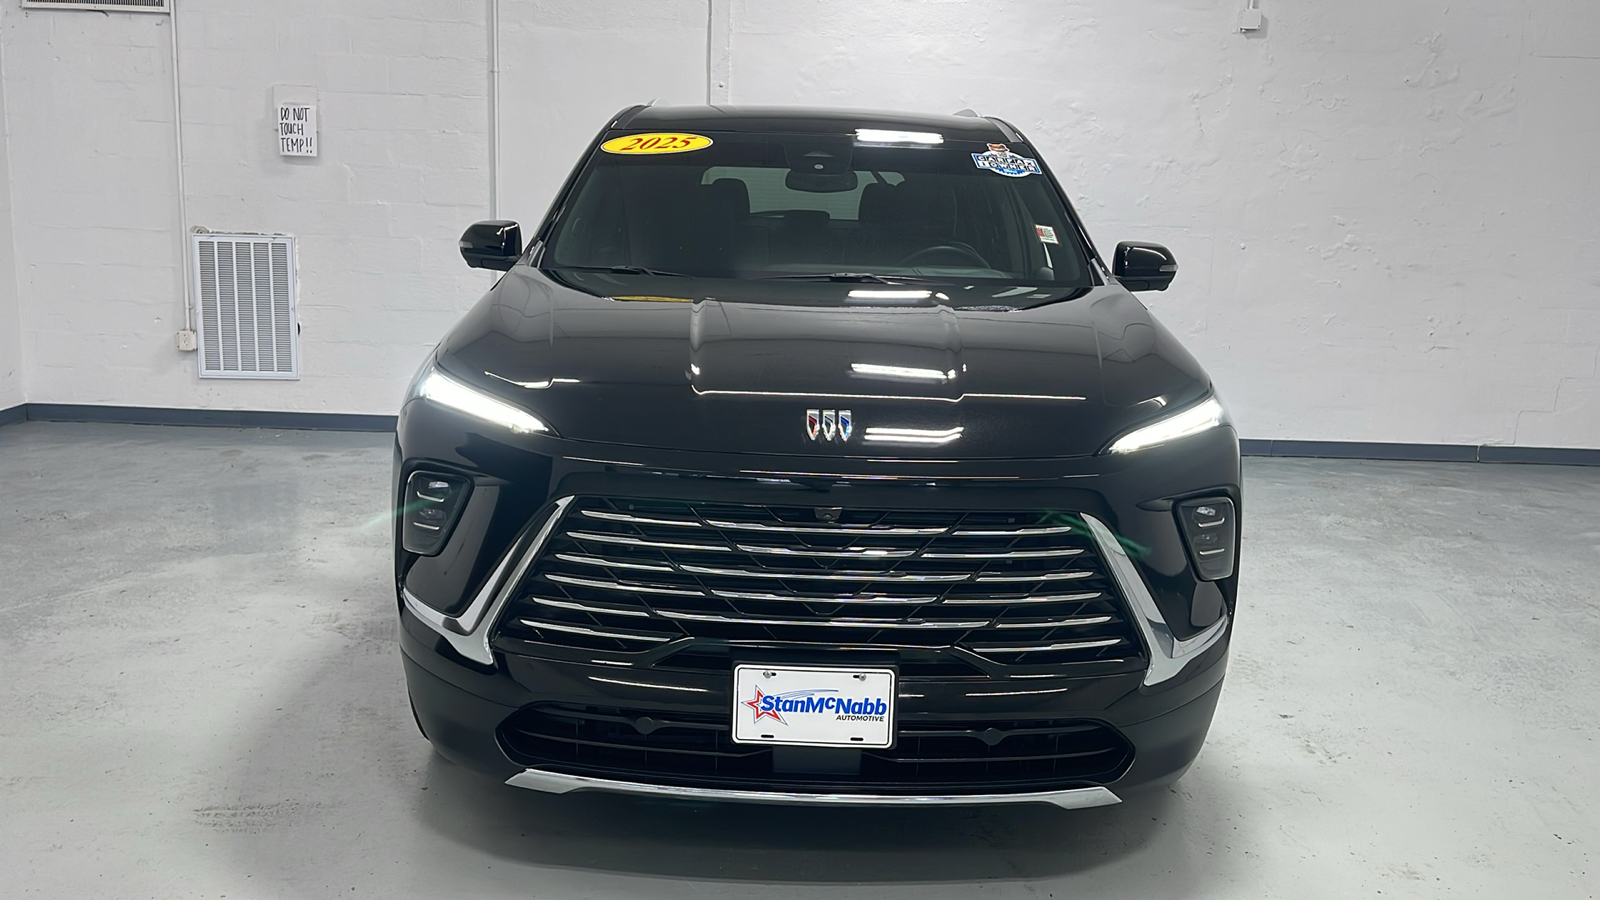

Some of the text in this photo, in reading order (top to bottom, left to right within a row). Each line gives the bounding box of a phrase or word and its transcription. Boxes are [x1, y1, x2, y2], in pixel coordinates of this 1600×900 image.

[280, 107, 310, 122] DO NOT
[279, 122, 304, 136] TOUCH
[280, 137, 313, 154] TEMP!!
[619, 136, 698, 151] 2025
[835, 714, 885, 722] AUTOMOTIVE
